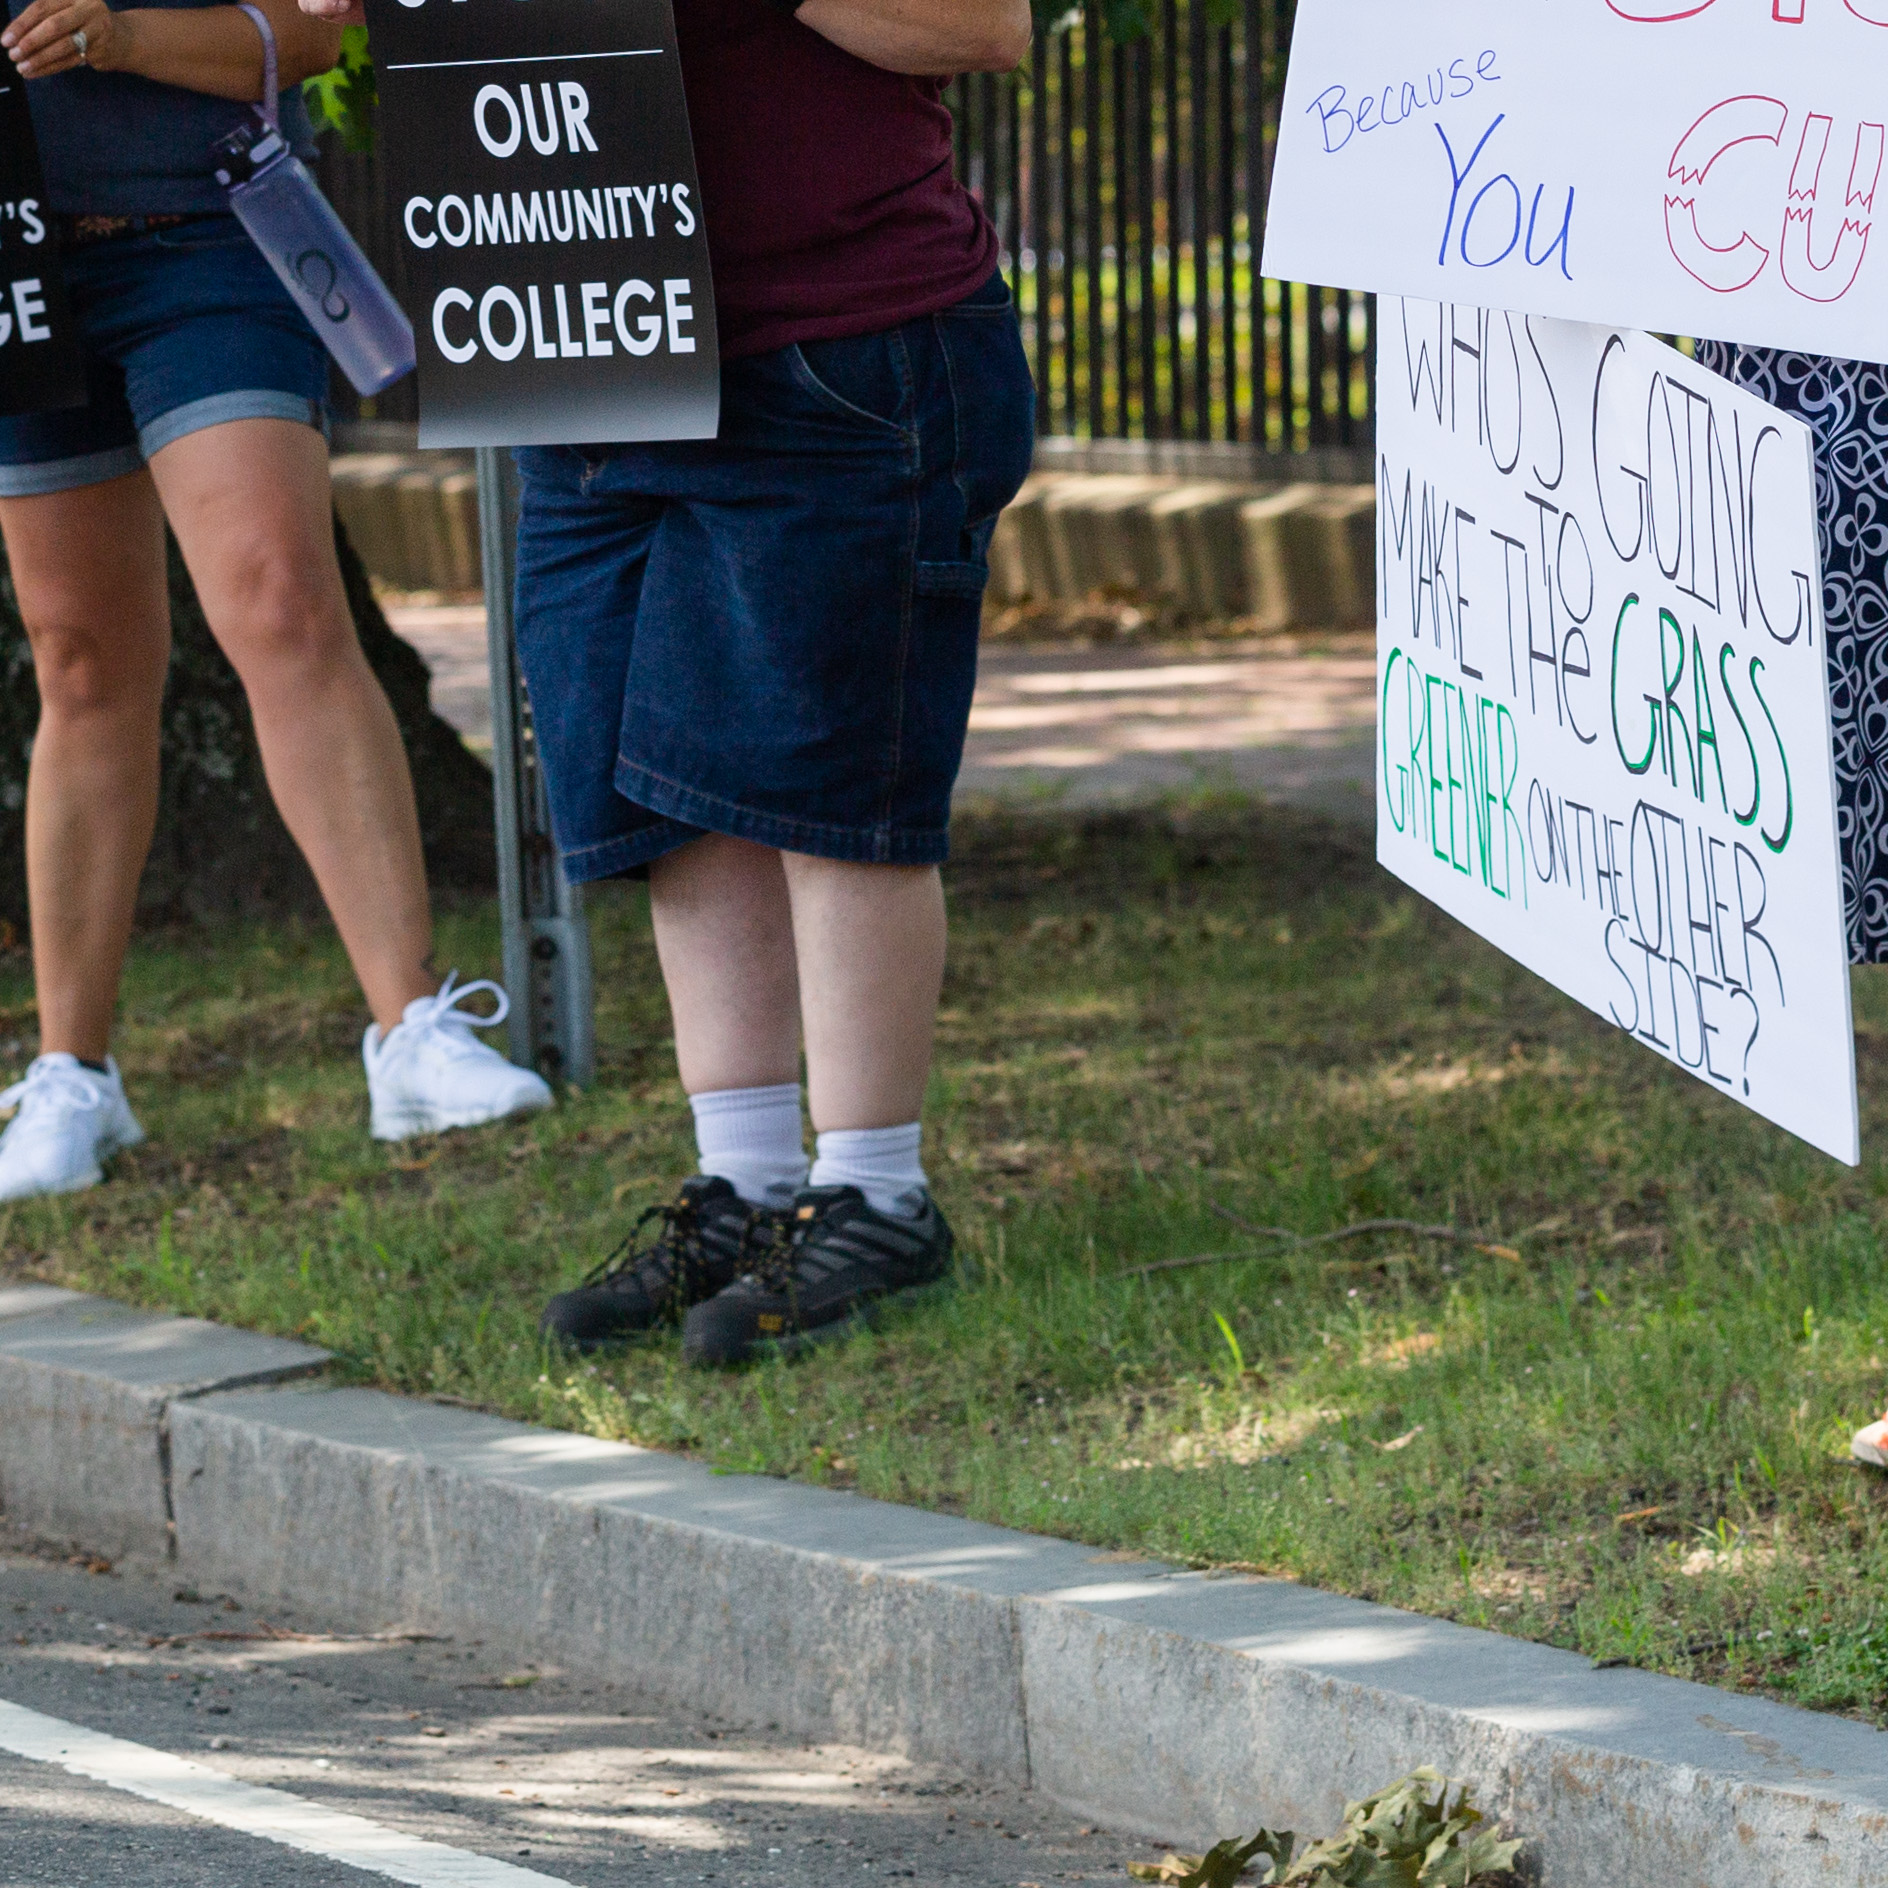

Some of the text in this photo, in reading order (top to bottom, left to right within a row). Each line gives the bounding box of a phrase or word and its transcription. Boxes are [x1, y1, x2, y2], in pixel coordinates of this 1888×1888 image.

[474, 82, 598, 157] OUR
[1305, 49, 1502, 154] Because
[405, 183, 695, 248] COMMUNITY'S
[433, 279, 695, 363] COLLEGE
[1524, 490, 1594, 625] TO
[1592, 333, 1812, 647] GOING
[1381, 452, 1483, 680] MAKE
[1610, 591, 1793, 854] GRASS
[1382, 646, 1529, 912] GREENER
[1630, 798, 1786, 1008] OTHER
[1603, 917, 1761, 1098] SIDE?
